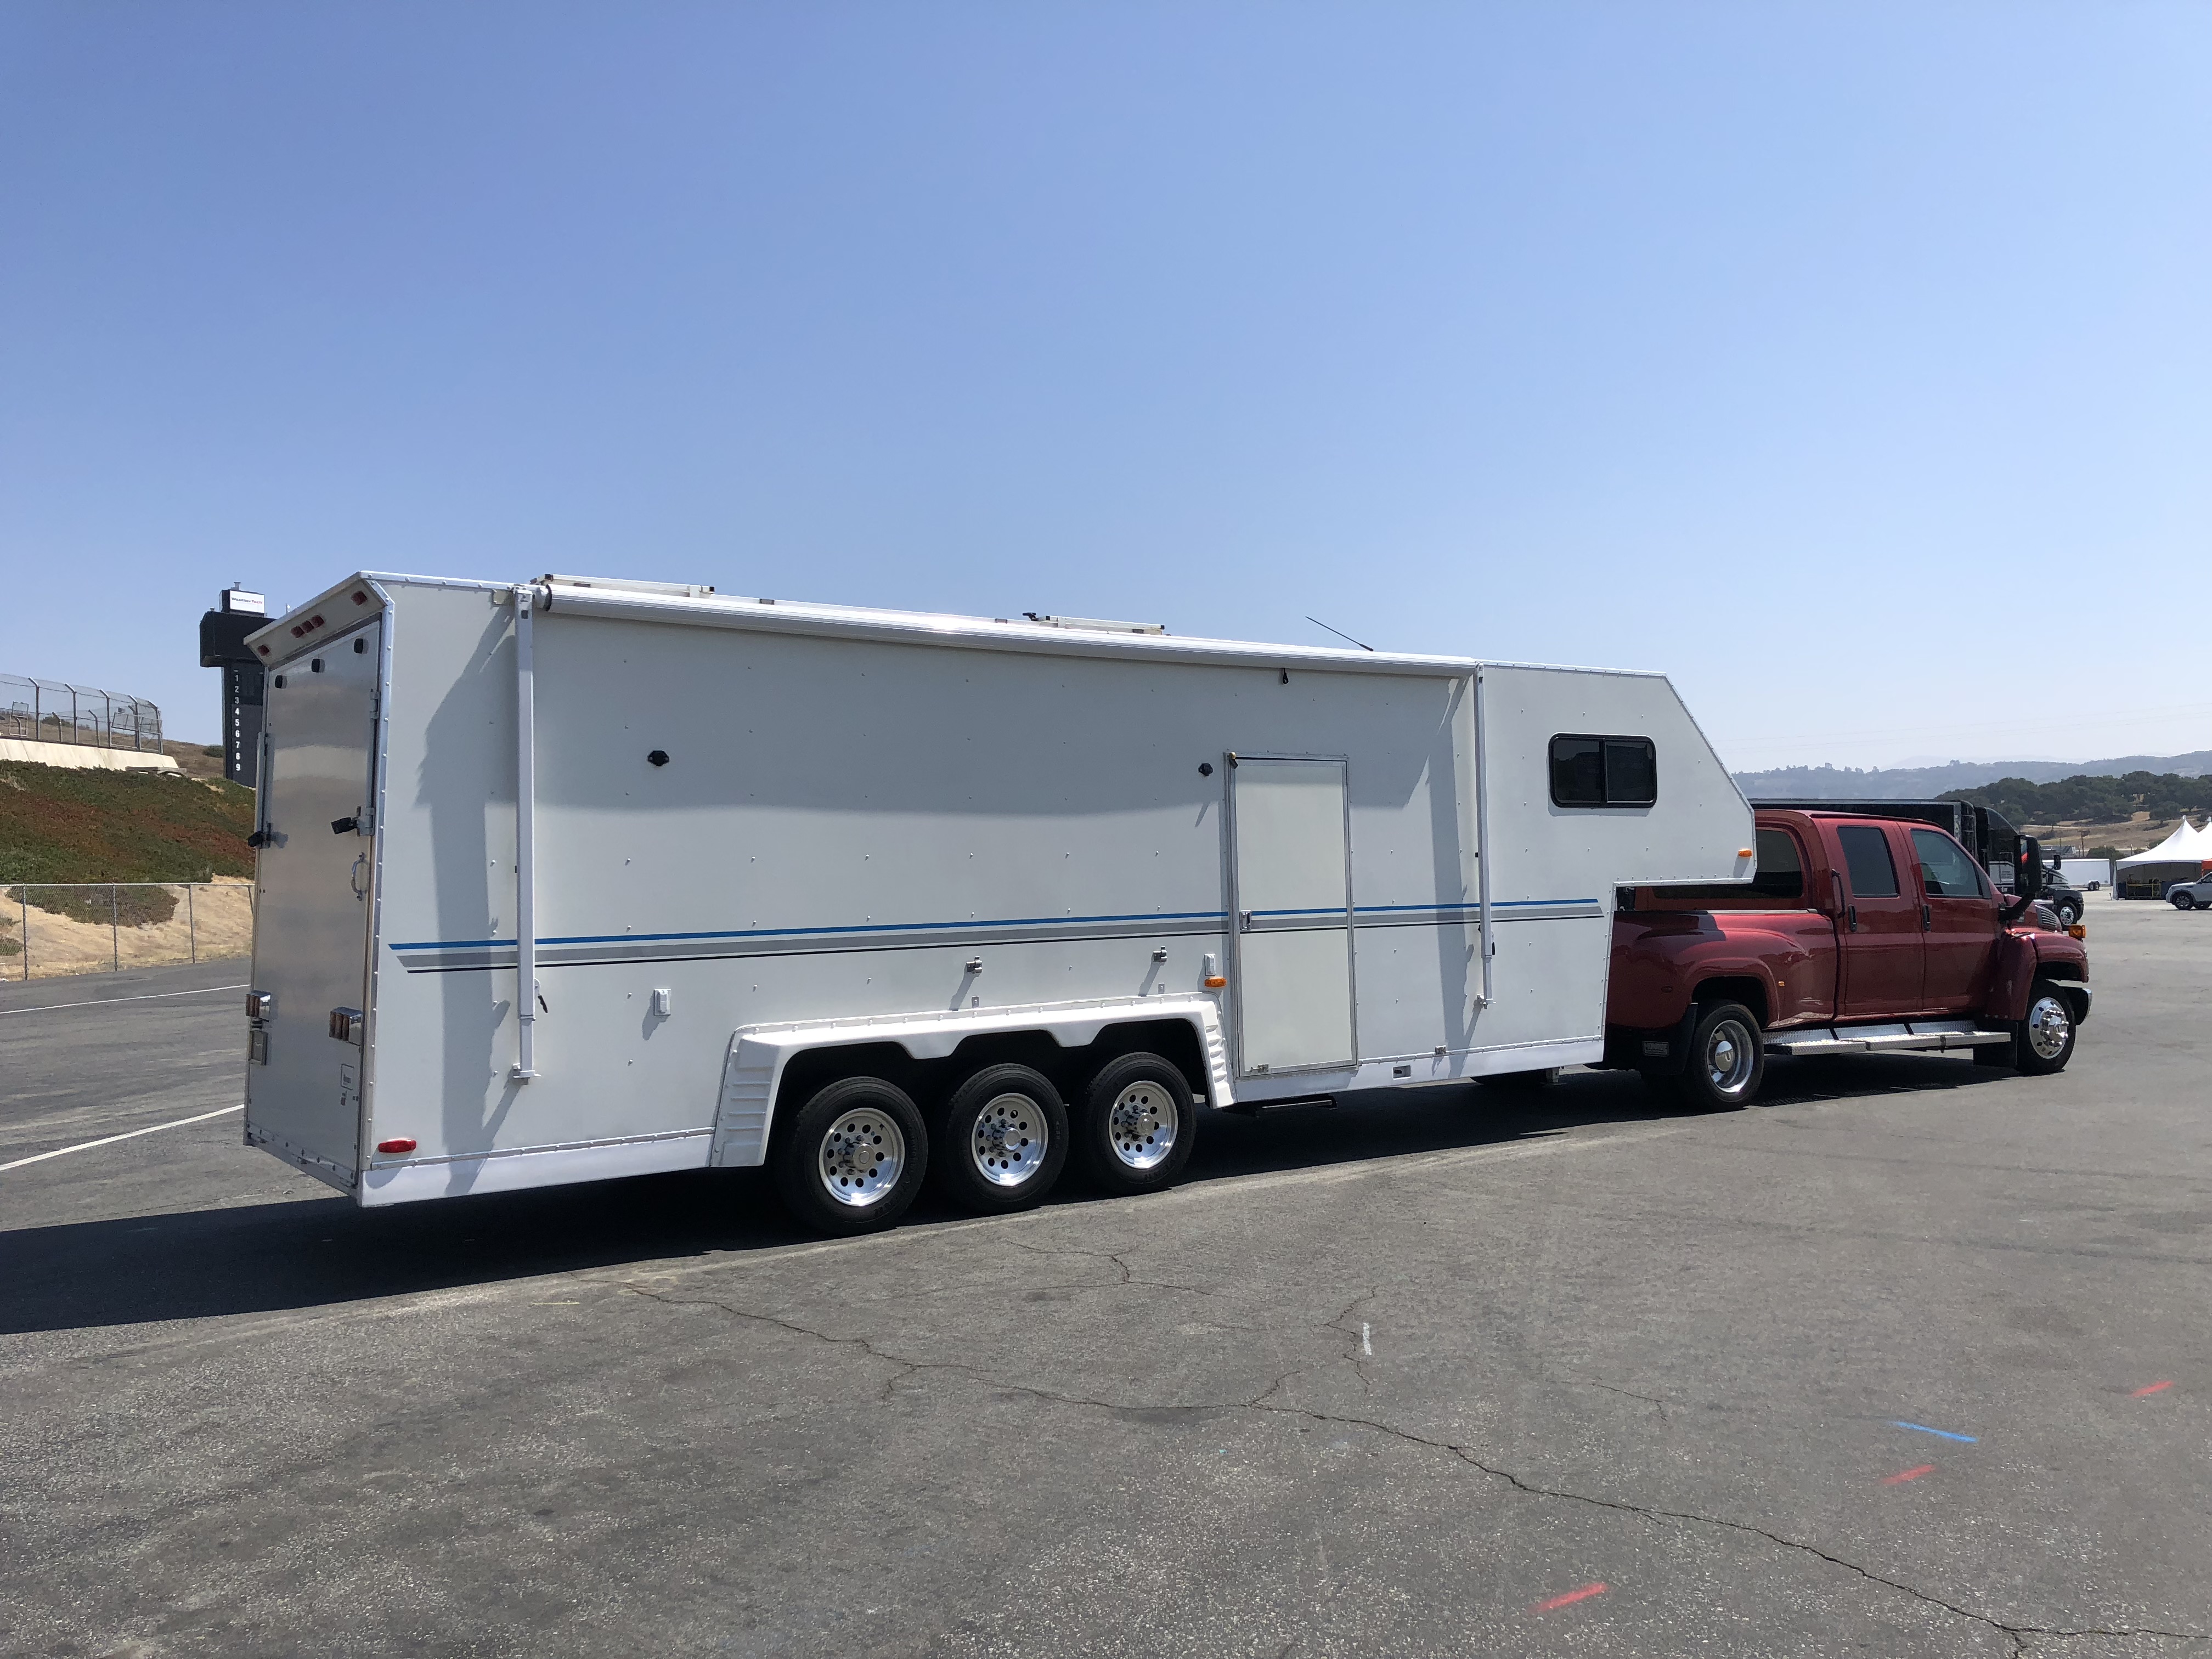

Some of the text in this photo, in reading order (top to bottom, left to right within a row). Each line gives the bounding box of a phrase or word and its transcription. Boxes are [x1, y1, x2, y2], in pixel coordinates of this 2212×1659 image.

[235, 696, 239, 704] 3
[235, 707, 240, 715] 4
[235, 719, 240, 727] 5
[235, 730, 240, 738] 6
[236, 752, 240, 760] 8
[236, 763, 241, 771] 9
